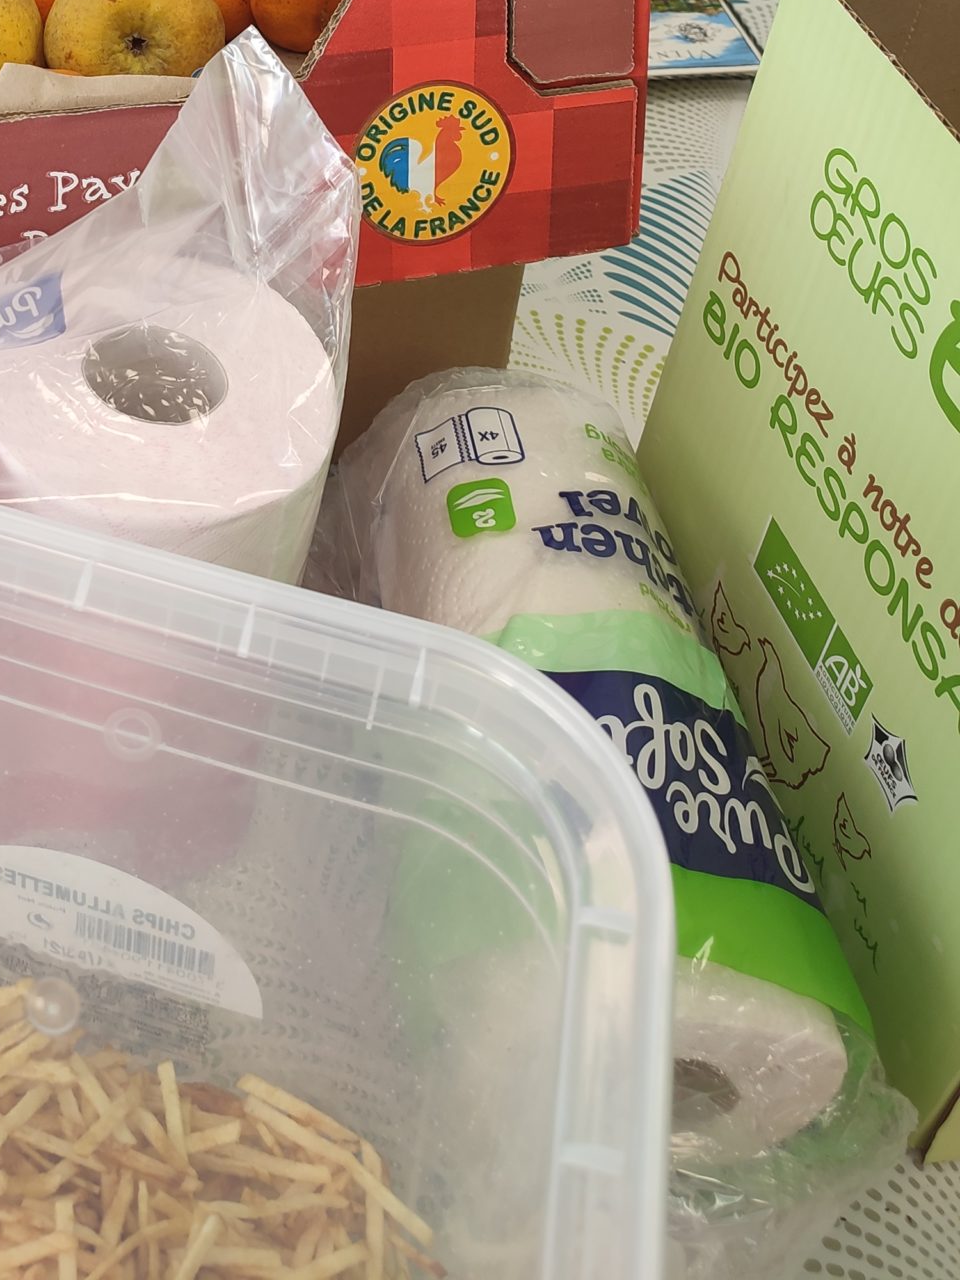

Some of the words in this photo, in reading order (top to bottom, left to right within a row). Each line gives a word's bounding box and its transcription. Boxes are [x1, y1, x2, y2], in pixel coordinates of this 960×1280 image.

[357, 91, 455, 161] ORIGINE
[458, 100, 500, 146] SUD
[361, 181, 383, 217] DE
[377, 209, 406, 237] LA
[413, 169, 501, 239] FRANCE
[823, 147, 938, 307] GROS
[702, 289, 761, 390] BIO
[430, 442, 448, 460] 45
[478, 430, 499, 442] 4X
[717, 251, 834, 439] Participez
[837, 432, 857, 475] à
[862, 473, 934, 590] notre
[472, 508, 496, 528] 2
[815, 669, 853, 736] BIOLOGIQUE
[818, 664, 855, 728] AGRICULTURE
[824, 655, 858, 707] AB
[665, 781, 816, 895] Pure
